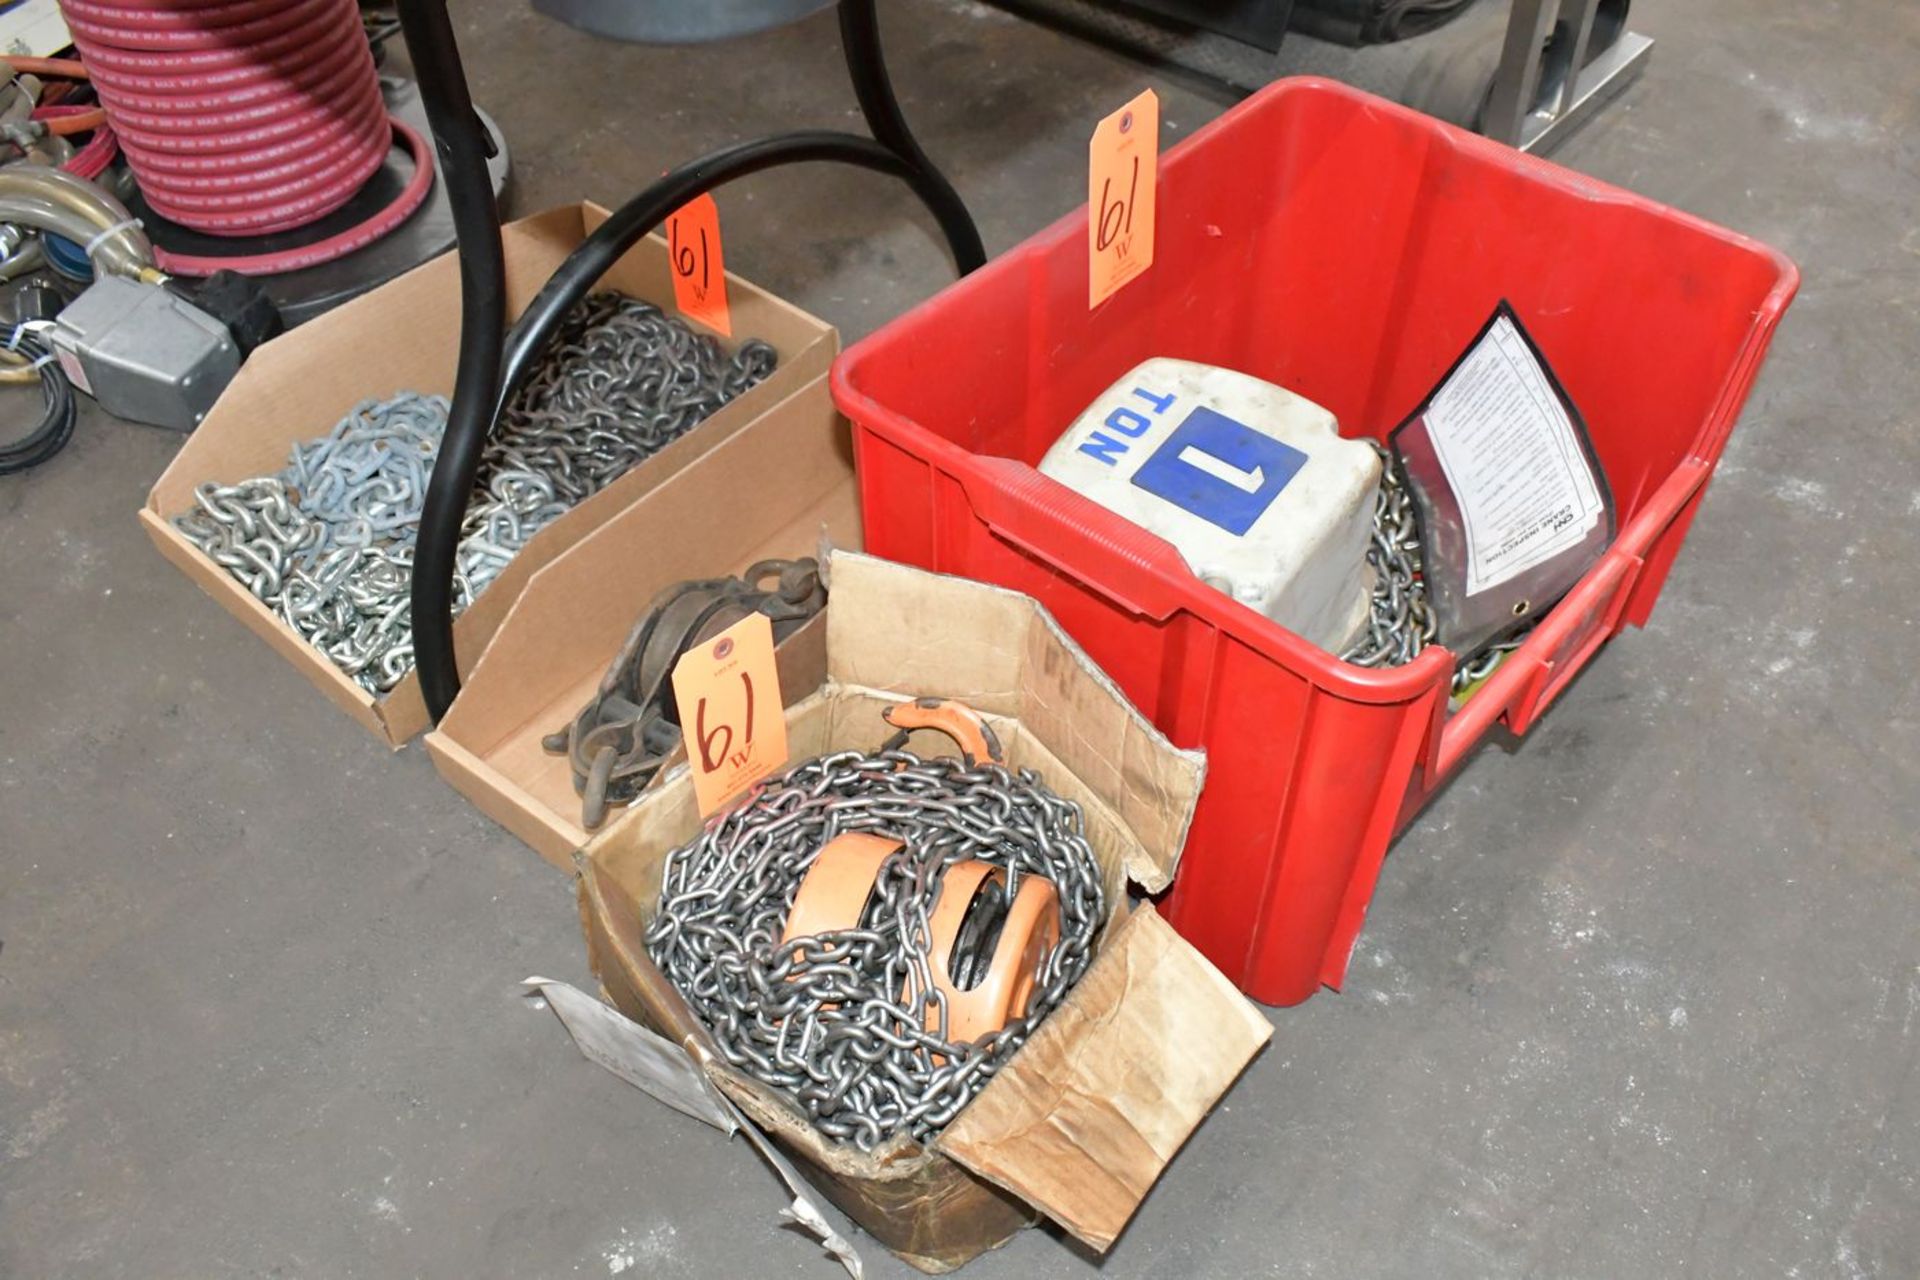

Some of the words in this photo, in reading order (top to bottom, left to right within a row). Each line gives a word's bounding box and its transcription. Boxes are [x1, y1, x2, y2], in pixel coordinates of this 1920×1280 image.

[1096, 155, 1139, 252] 61
[672, 217, 708, 289] 61
[1113, 233, 1135, 260] W
[1077, 387, 1178, 467] TON
[1177, 444, 1266, 495] 1
[1541, 504, 1571, 528] CRANE
[1485, 527, 1540, 564] INSPECTION
[696, 671, 752, 774] 61
[727, 742, 756, 770] W
